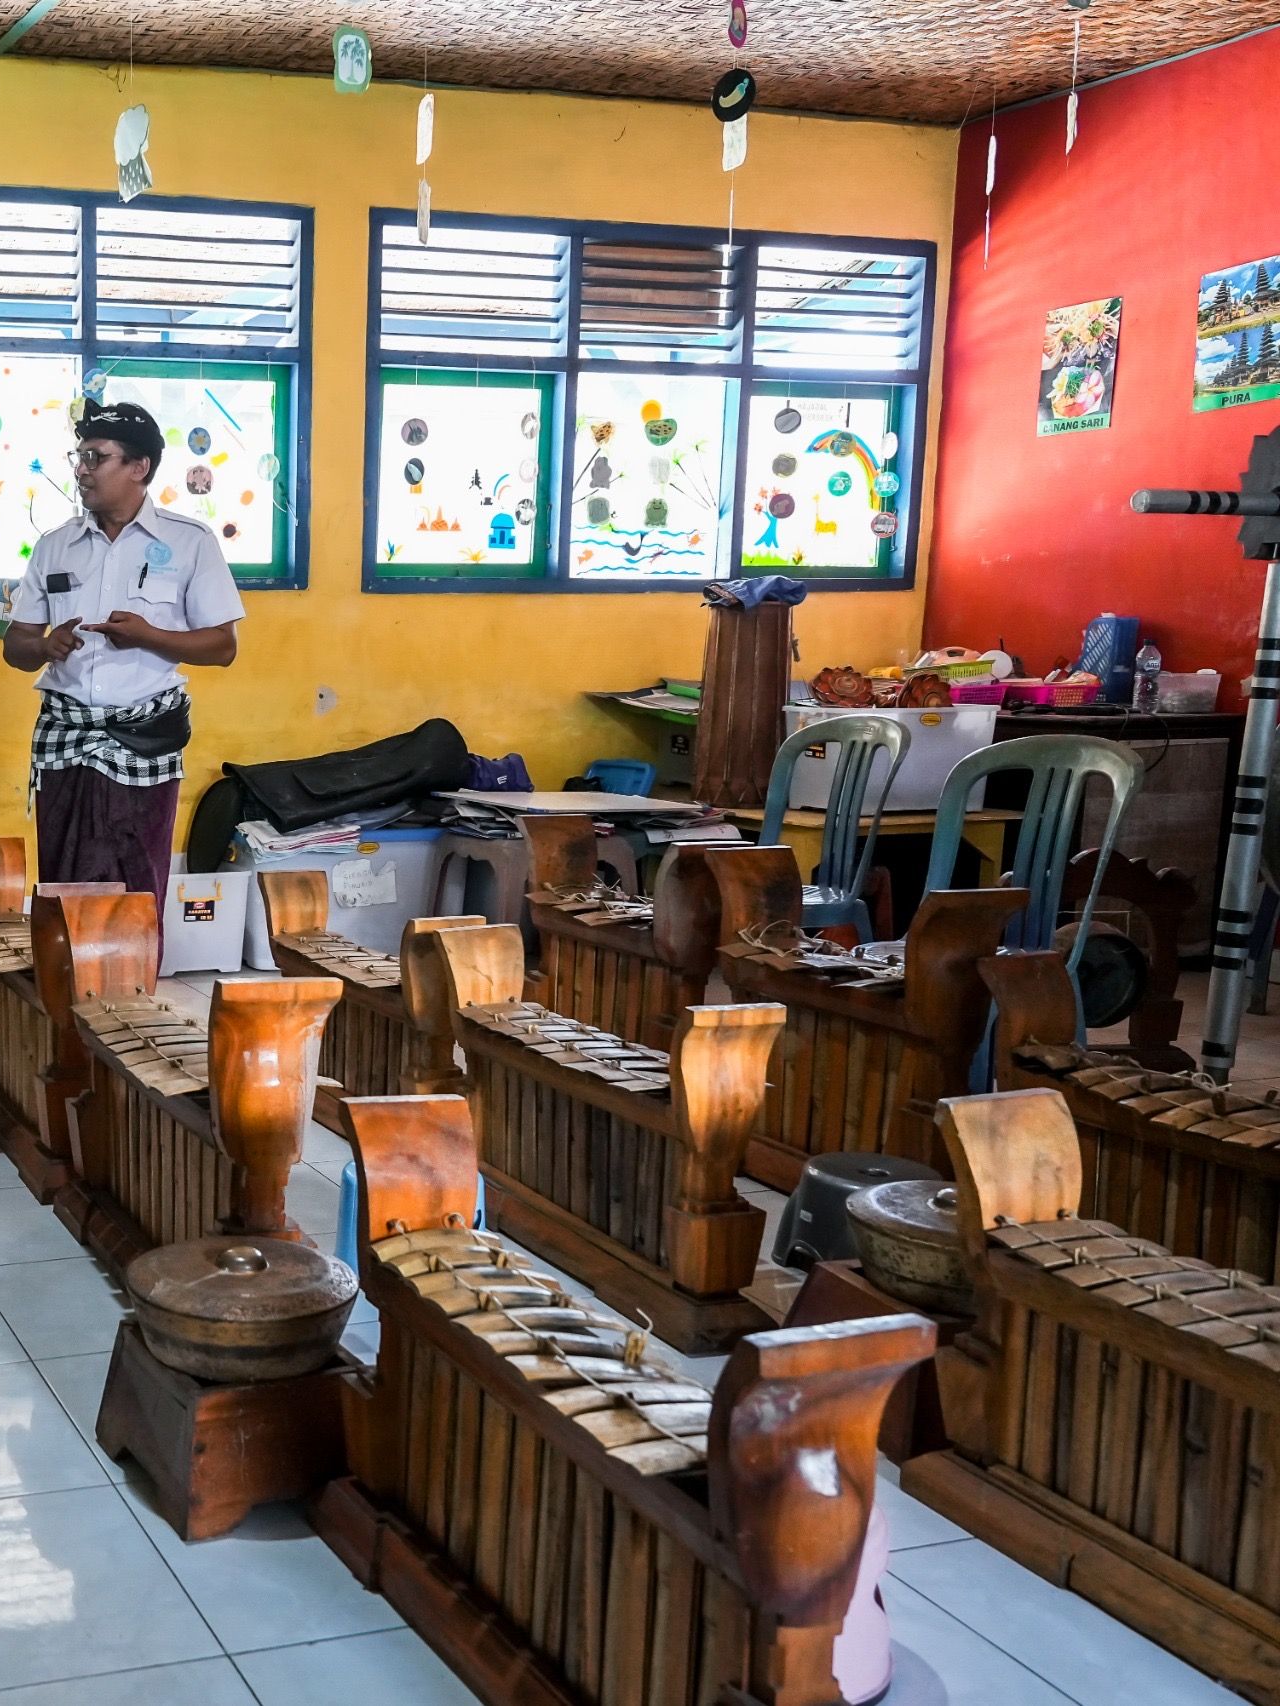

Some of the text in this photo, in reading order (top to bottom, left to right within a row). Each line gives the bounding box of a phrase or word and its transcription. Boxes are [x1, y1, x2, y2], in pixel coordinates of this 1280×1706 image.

[1221, 392, 1251, 406] PURA
[1043, 417, 1104, 432] CANANG SARI
